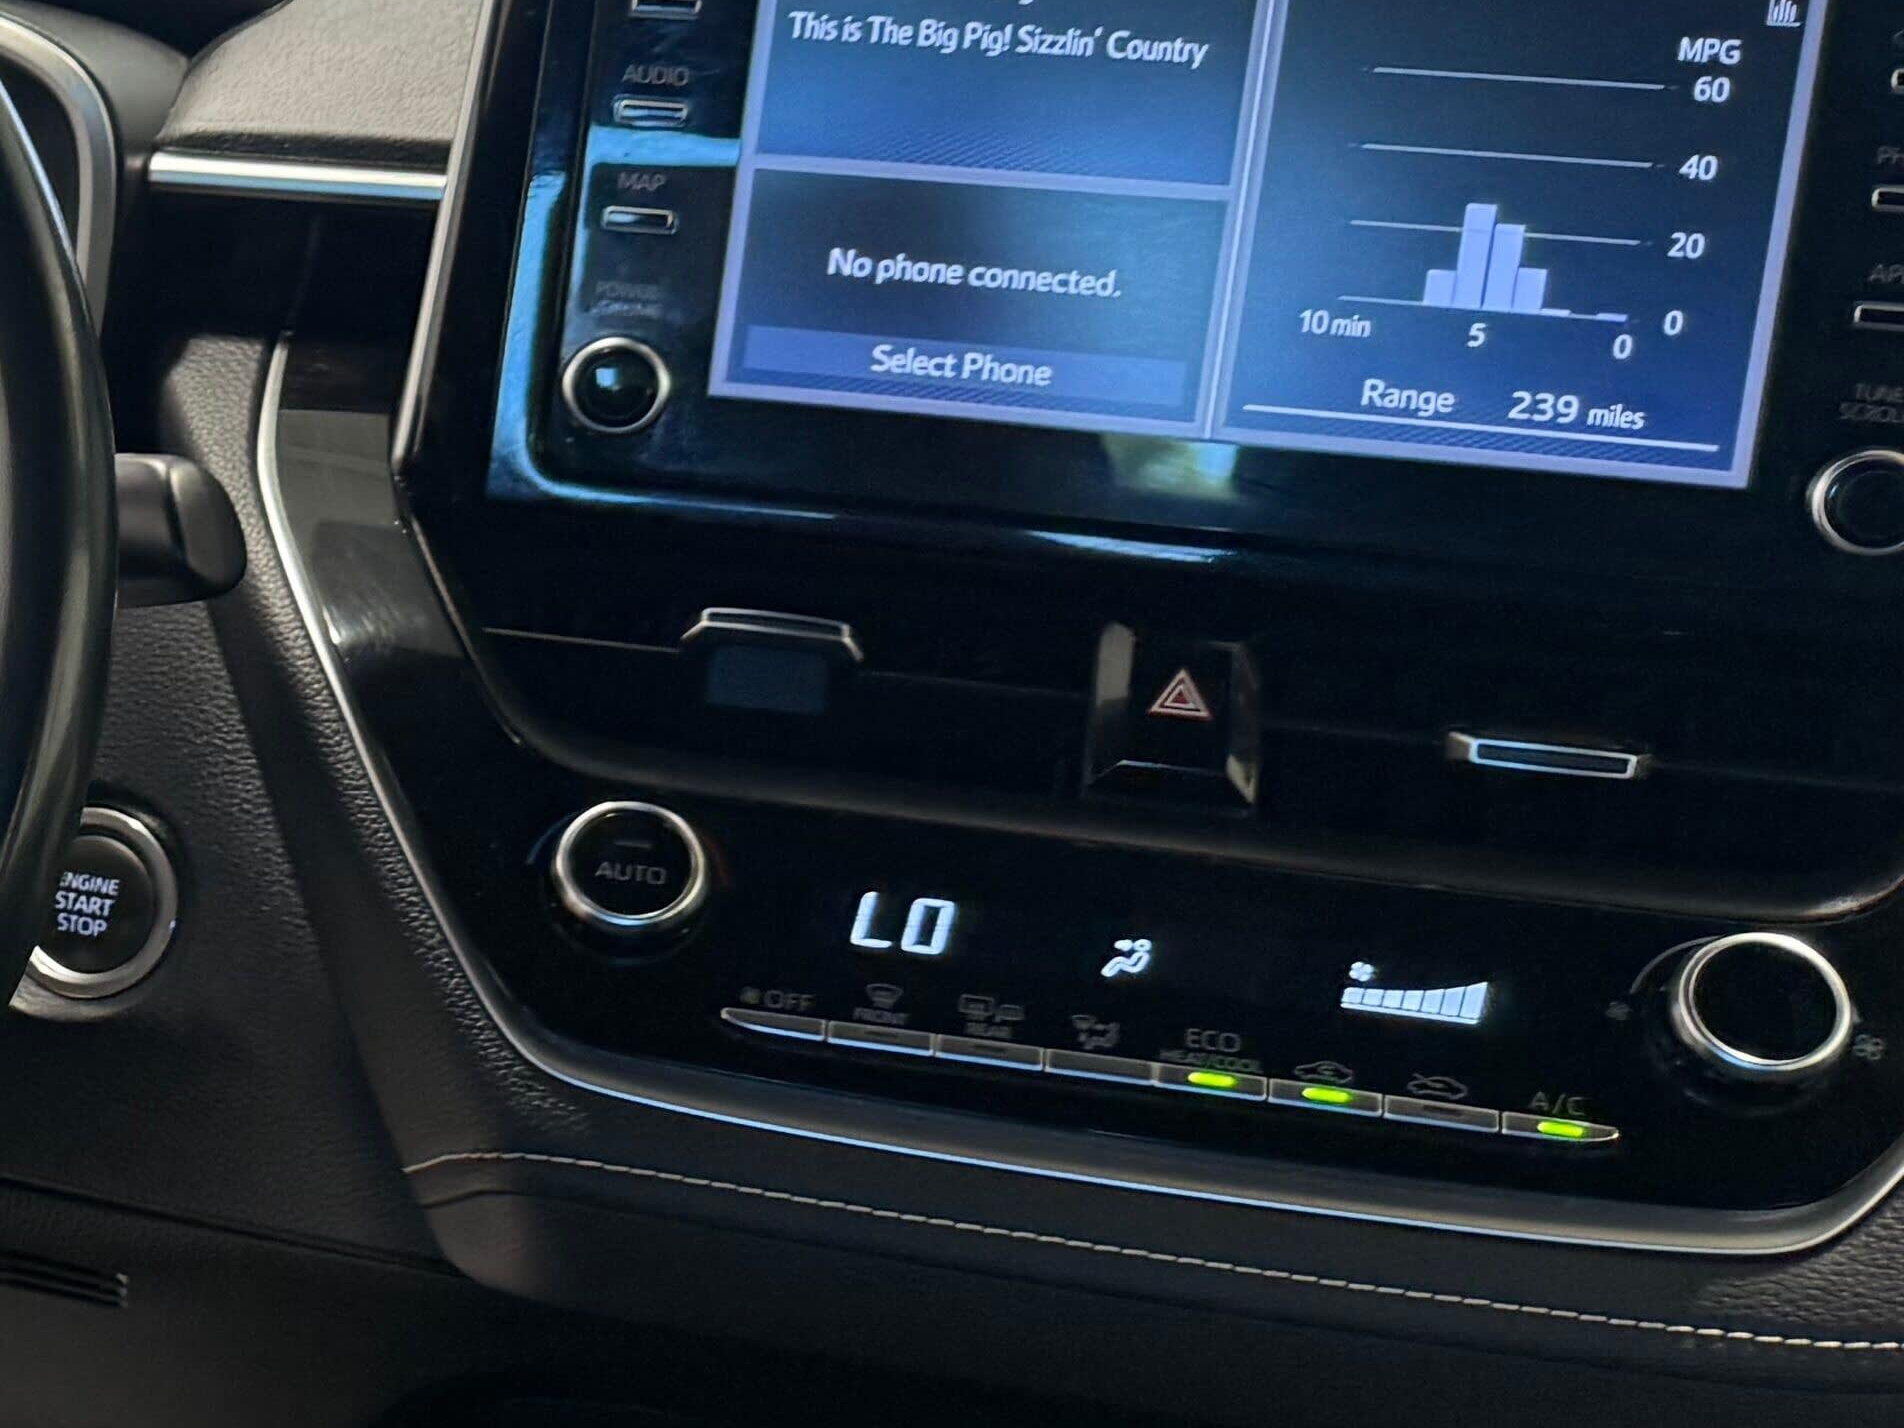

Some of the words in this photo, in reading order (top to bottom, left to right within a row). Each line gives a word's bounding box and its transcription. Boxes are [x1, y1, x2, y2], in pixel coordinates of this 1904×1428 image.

[787, 9, 839, 44] This
[841, 15, 863, 44] is
[864, 15, 914, 49] The
[917, 19, 959, 55] Big
[962, 21, 1012, 57] Pig!
[1015, 24, 1102, 57] Sizzlin'
[1106, 31, 1210, 71] Country
[1677, 36, 1743, 66] MPG
[622, 63, 690, 89] AUDIO
[1693, 75, 1732, 105] 60
[1678, 154, 1719, 182] 40
[616, 171, 666, 195] MAP
[1667, 230, 1705, 261] 20
[827, 246, 873, 279] No
[874, 257, 964, 289] phone
[966, 264, 1123, 299] connected.
[1298, 307, 1328, 338] 10
[1330, 313, 1372, 340] min
[1466, 322, 1487, 349] 5
[1611, 333, 1634, 362] 0
[1662, 310, 1684, 337] 0
[869, 344, 958, 379] Select
[960, 351, 1054, 388] Phone
[1359, 377, 1456, 416] Range
[1507, 390, 1580, 426] 239
[1587, 403, 1648, 432] miles
[59, 870, 121, 897] ENGINE
[594, 858, 668, 887] AUTO
[54, 889, 116, 918] START
[56, 911, 108, 938] STOP
[849, 889, 957, 957] LO
[762, 988, 816, 1014] OFF
[1183, 1026, 1243, 1054] ECO
[1527, 1088, 1586, 1119] A/C
